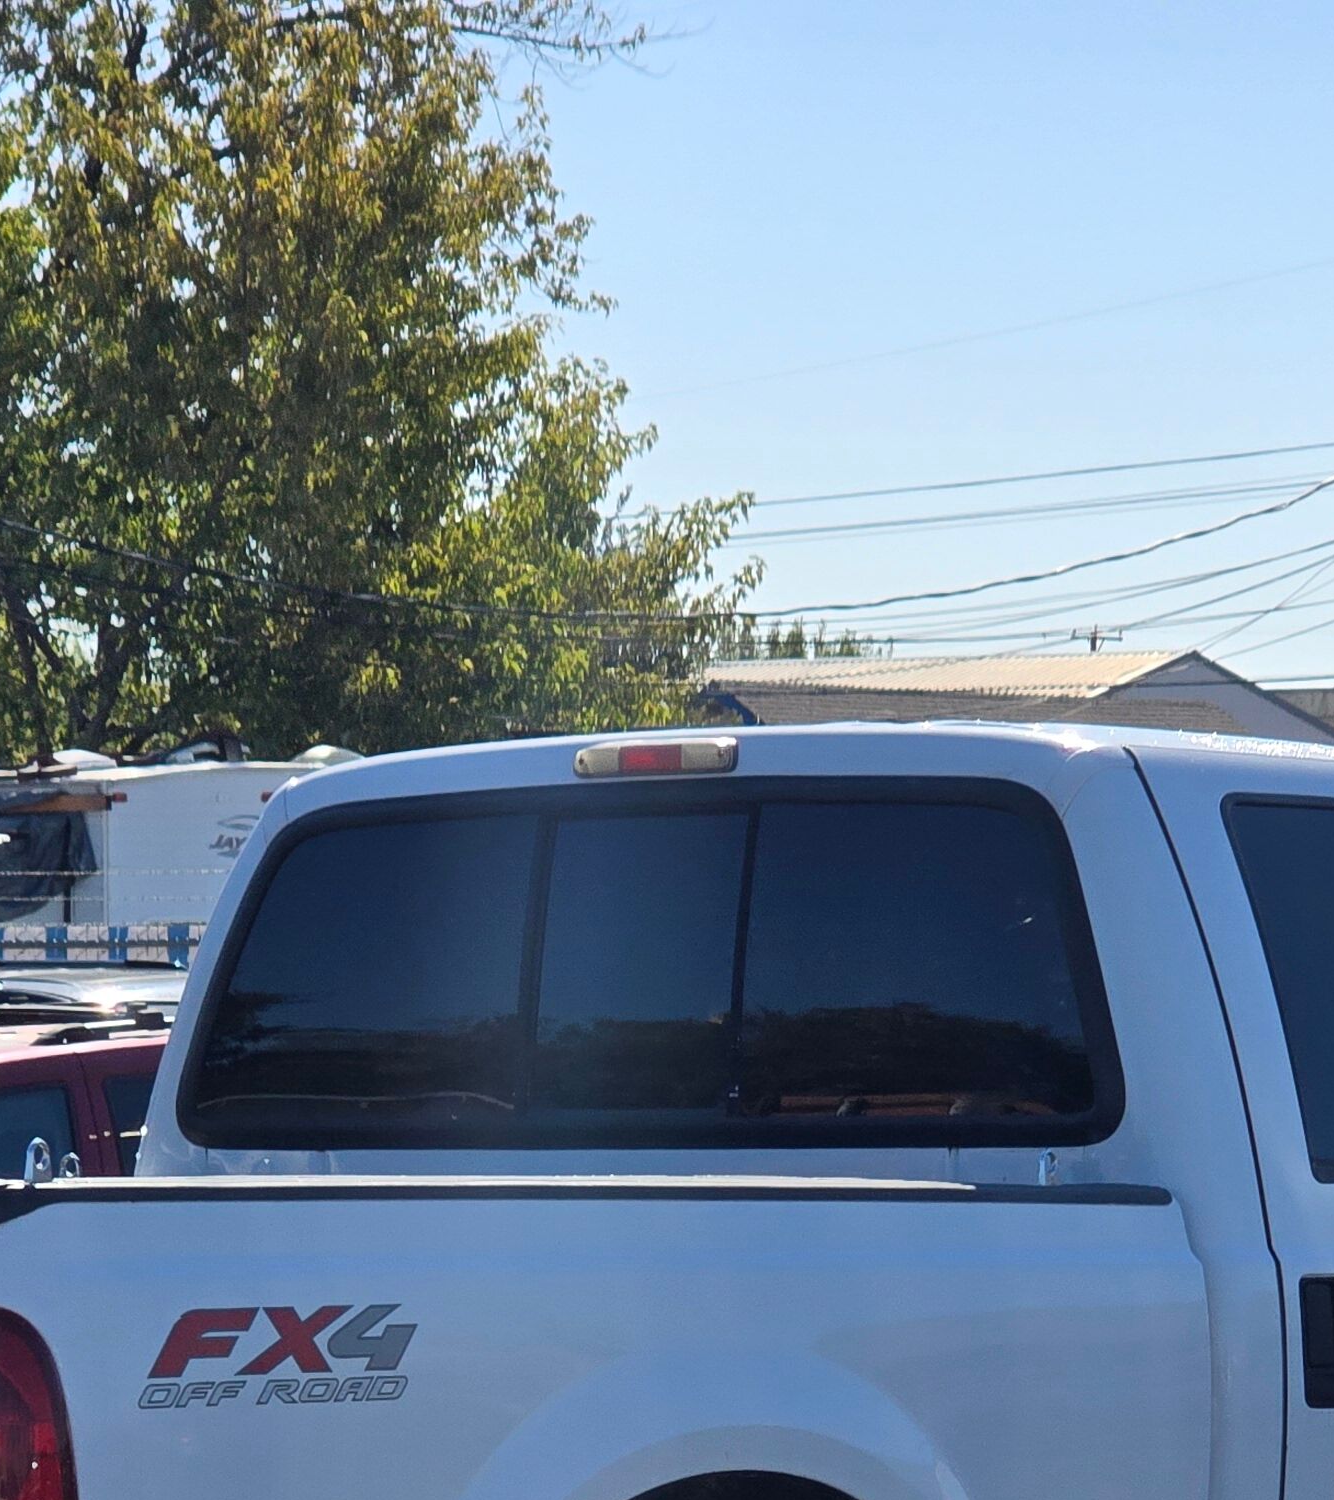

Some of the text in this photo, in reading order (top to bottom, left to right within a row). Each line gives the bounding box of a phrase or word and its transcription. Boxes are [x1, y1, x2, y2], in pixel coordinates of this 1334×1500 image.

[147, 1303, 418, 1379] FX4
[138, 1375, 409, 1409] OFF ROAD
